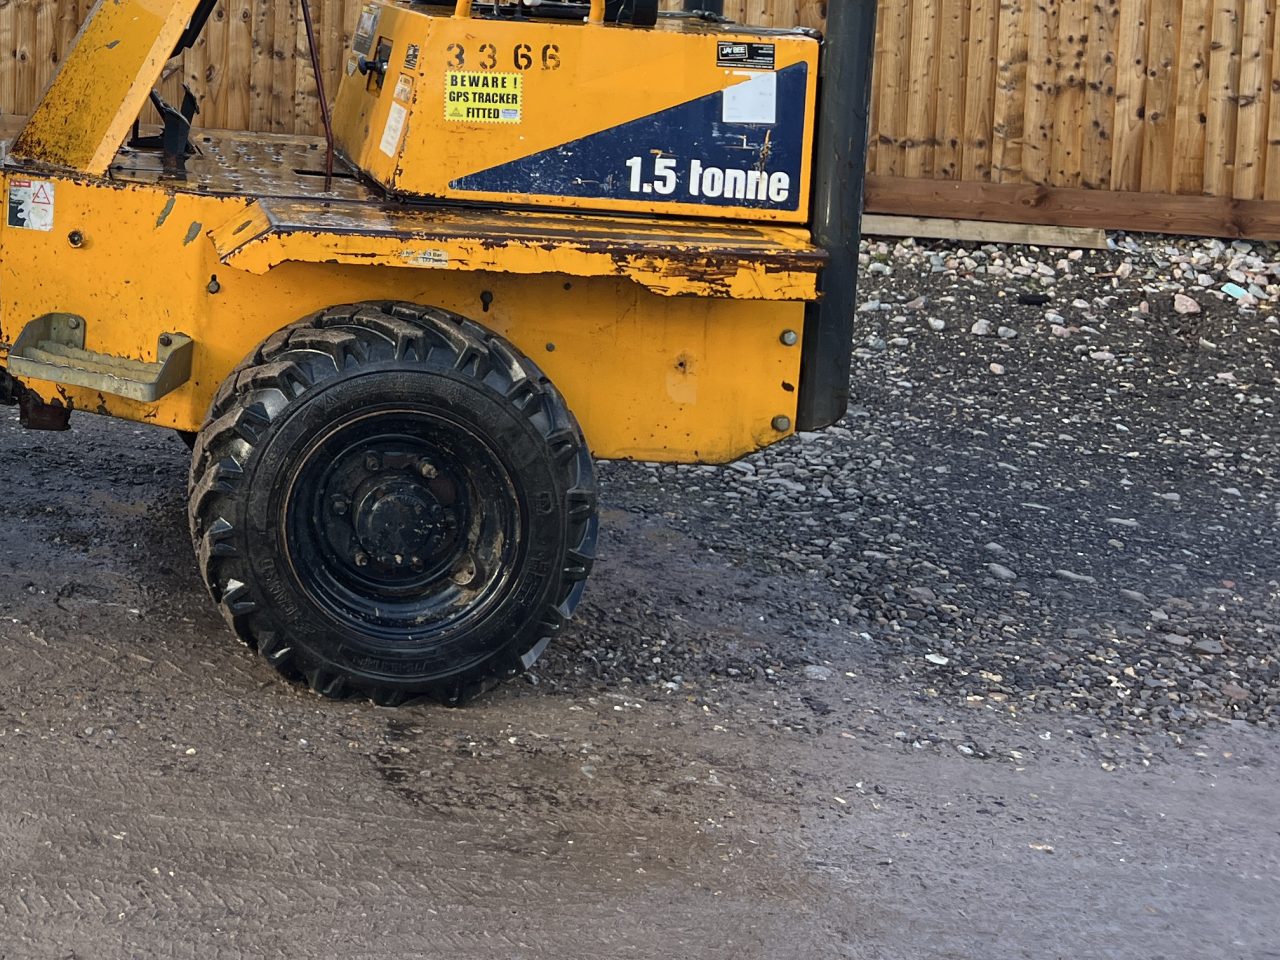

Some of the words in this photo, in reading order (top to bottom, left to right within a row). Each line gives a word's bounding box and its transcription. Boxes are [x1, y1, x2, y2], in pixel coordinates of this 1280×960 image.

[450, 75, 507, 88] BEWARE
[448, 91, 469, 102] GPS
[472, 92, 518, 104] TRACKER
[466, 107, 500, 119] FITTED
[626, 156, 677, 195] 1.5
[688, 159, 790, 202] tonne
